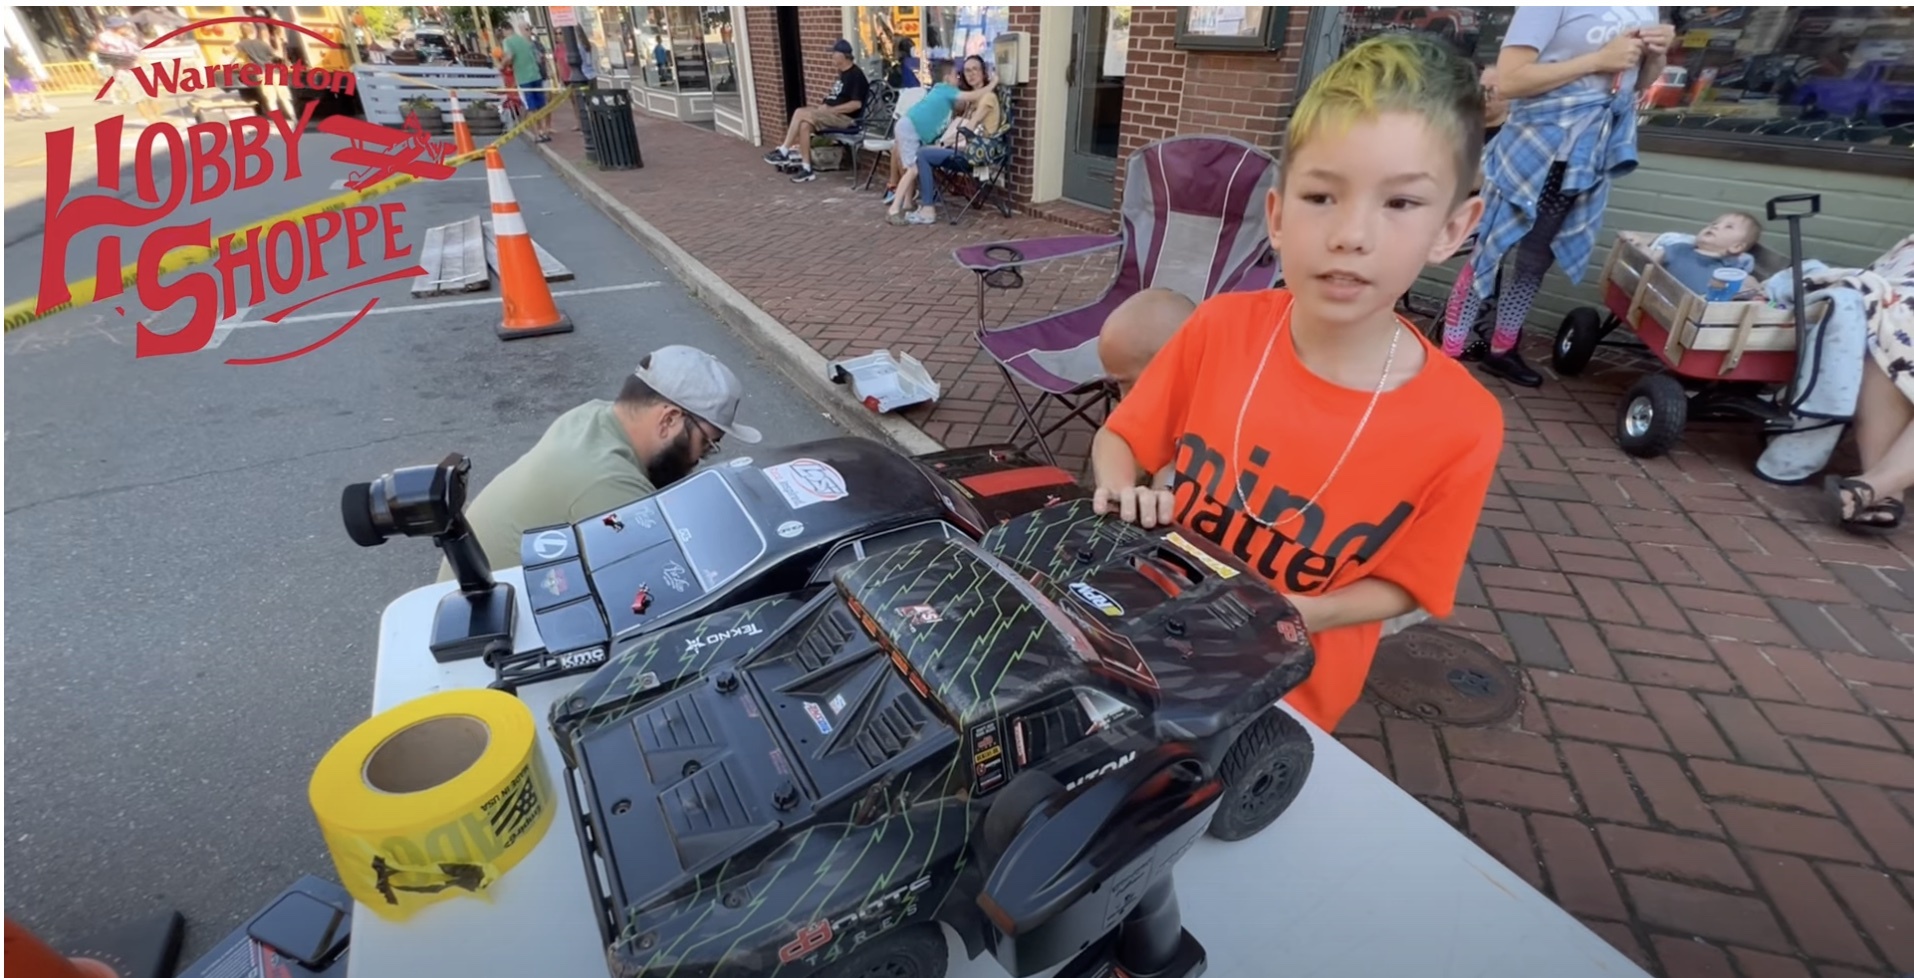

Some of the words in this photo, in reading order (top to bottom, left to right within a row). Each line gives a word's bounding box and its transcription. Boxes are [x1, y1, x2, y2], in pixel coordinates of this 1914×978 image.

[1176, 432, 1415, 562] mind
[706, 623, 763, 645] TEKNO
[511, 764, 529, 787] MADE
[481, 794, 500, 812] USA
